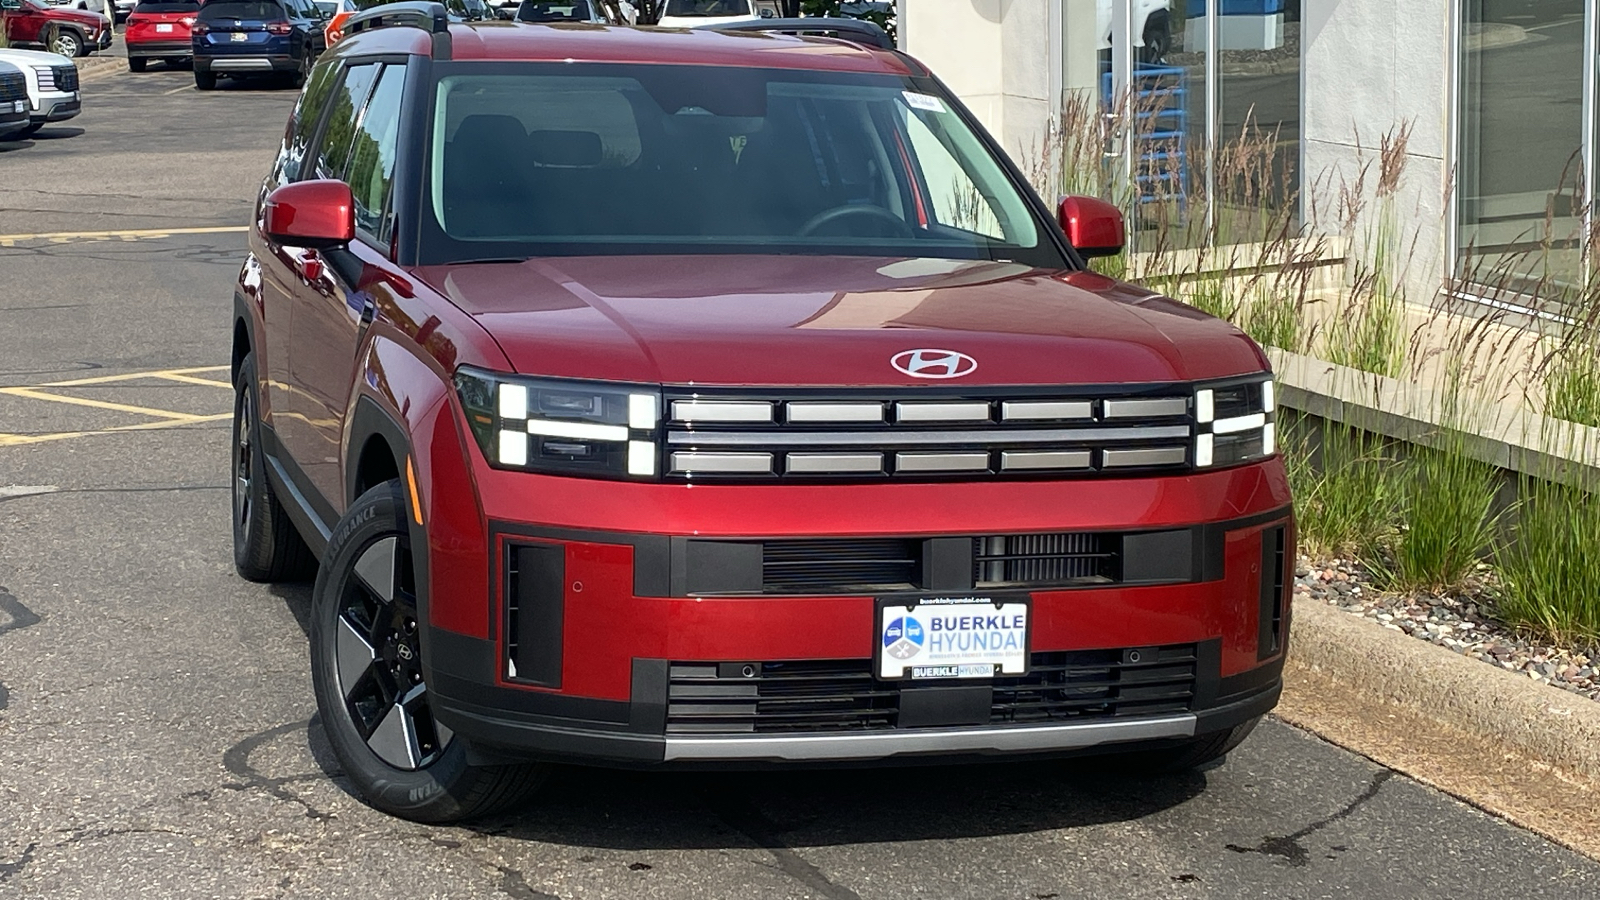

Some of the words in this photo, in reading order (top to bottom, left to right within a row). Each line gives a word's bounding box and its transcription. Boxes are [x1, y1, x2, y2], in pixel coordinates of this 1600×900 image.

[931, 615, 1024, 631] BUERKLE
[929, 631, 1025, 652] HYUNDAI
[913, 665, 958, 677] BUERKLE
[959, 665, 992, 675] HYUNDAI
